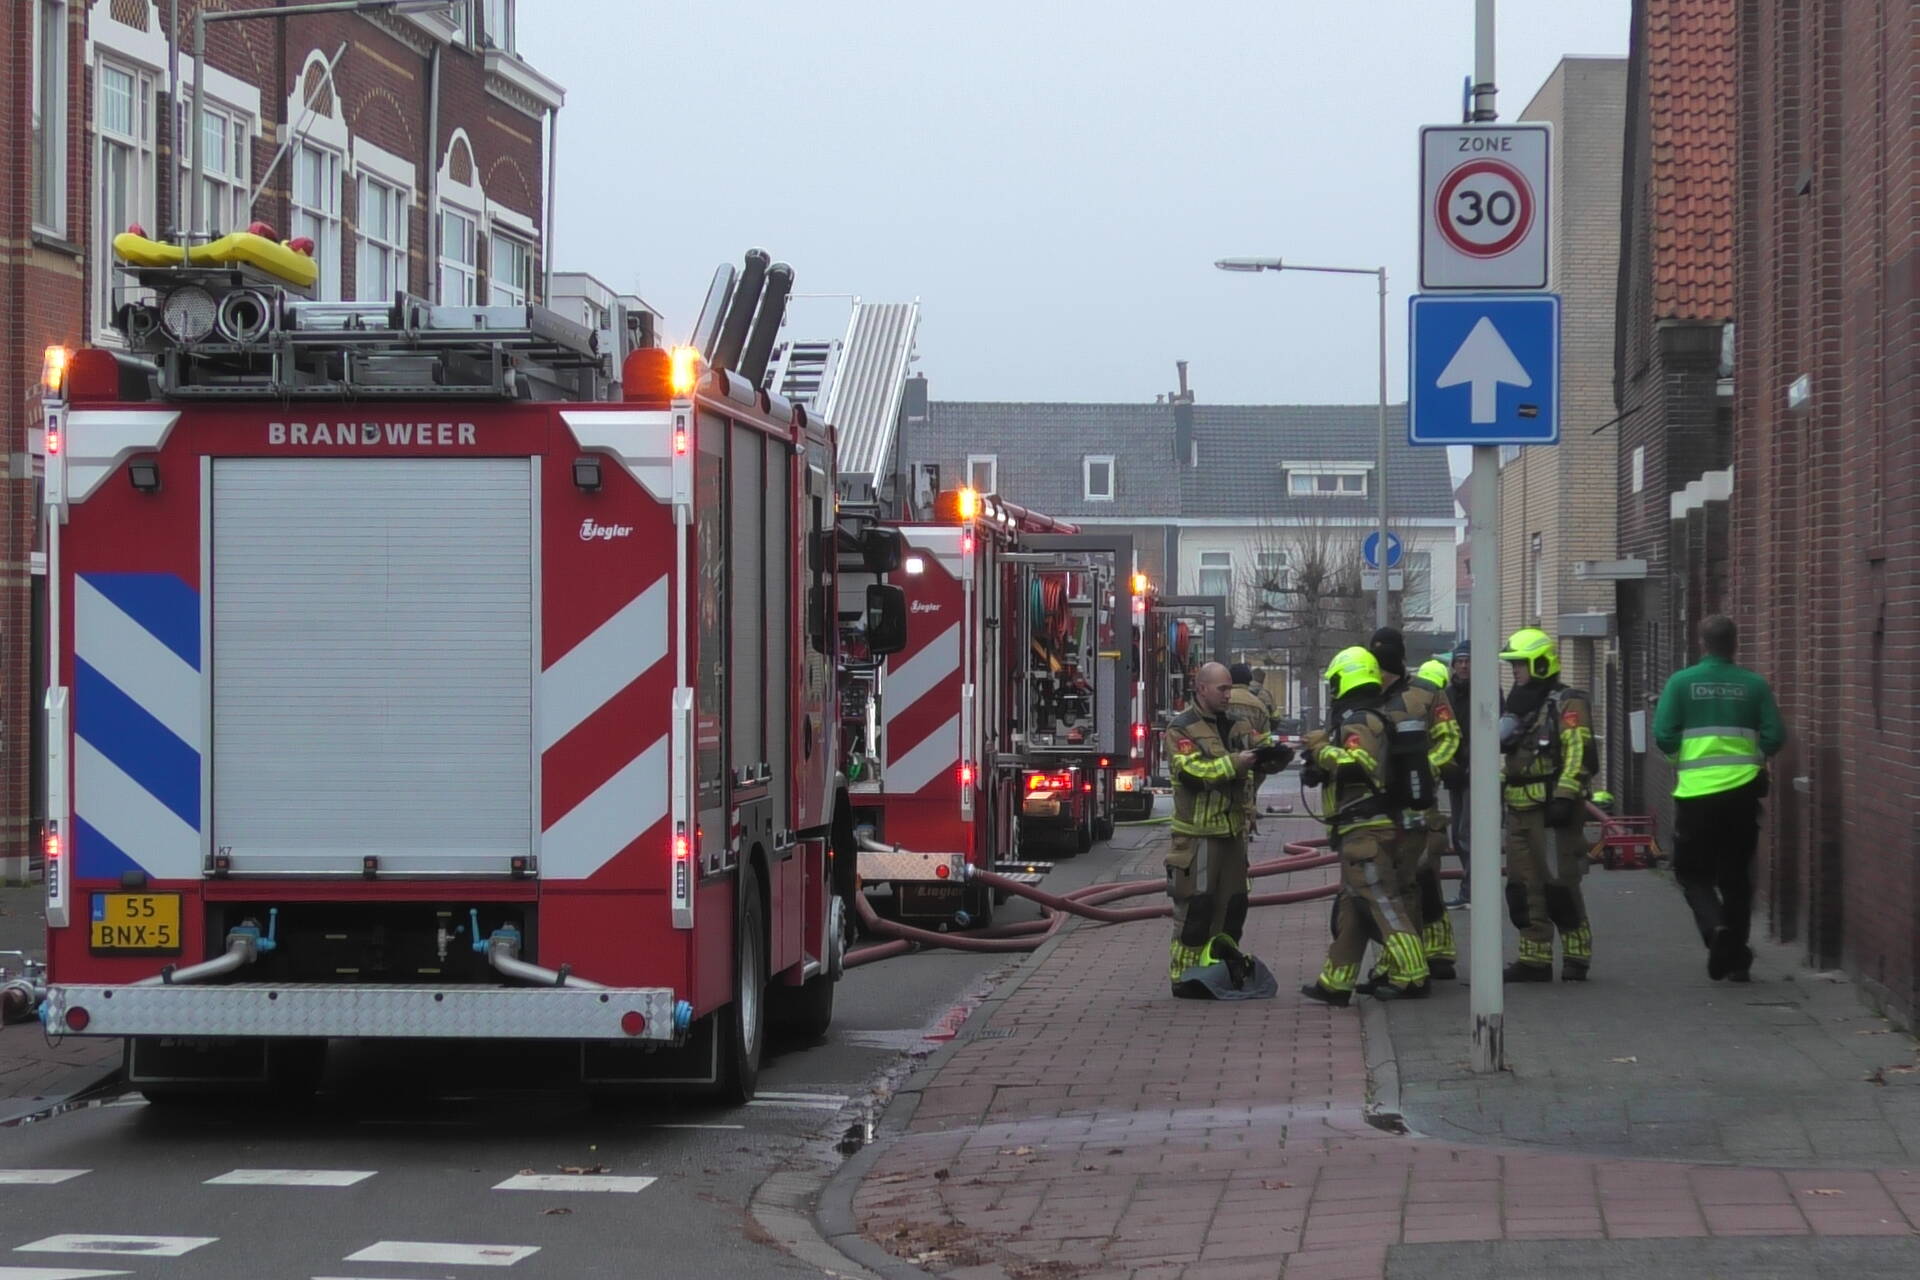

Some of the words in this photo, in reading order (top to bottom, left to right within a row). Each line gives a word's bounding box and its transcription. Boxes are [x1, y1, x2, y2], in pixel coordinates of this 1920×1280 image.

[1458, 137, 1512, 152] ZONE
[1456, 190, 1516, 226] 30
[268, 422, 477, 446] BRANDWEER
[126, 898, 155, 918] 55
[101, 925, 170, 945] BNX-5
